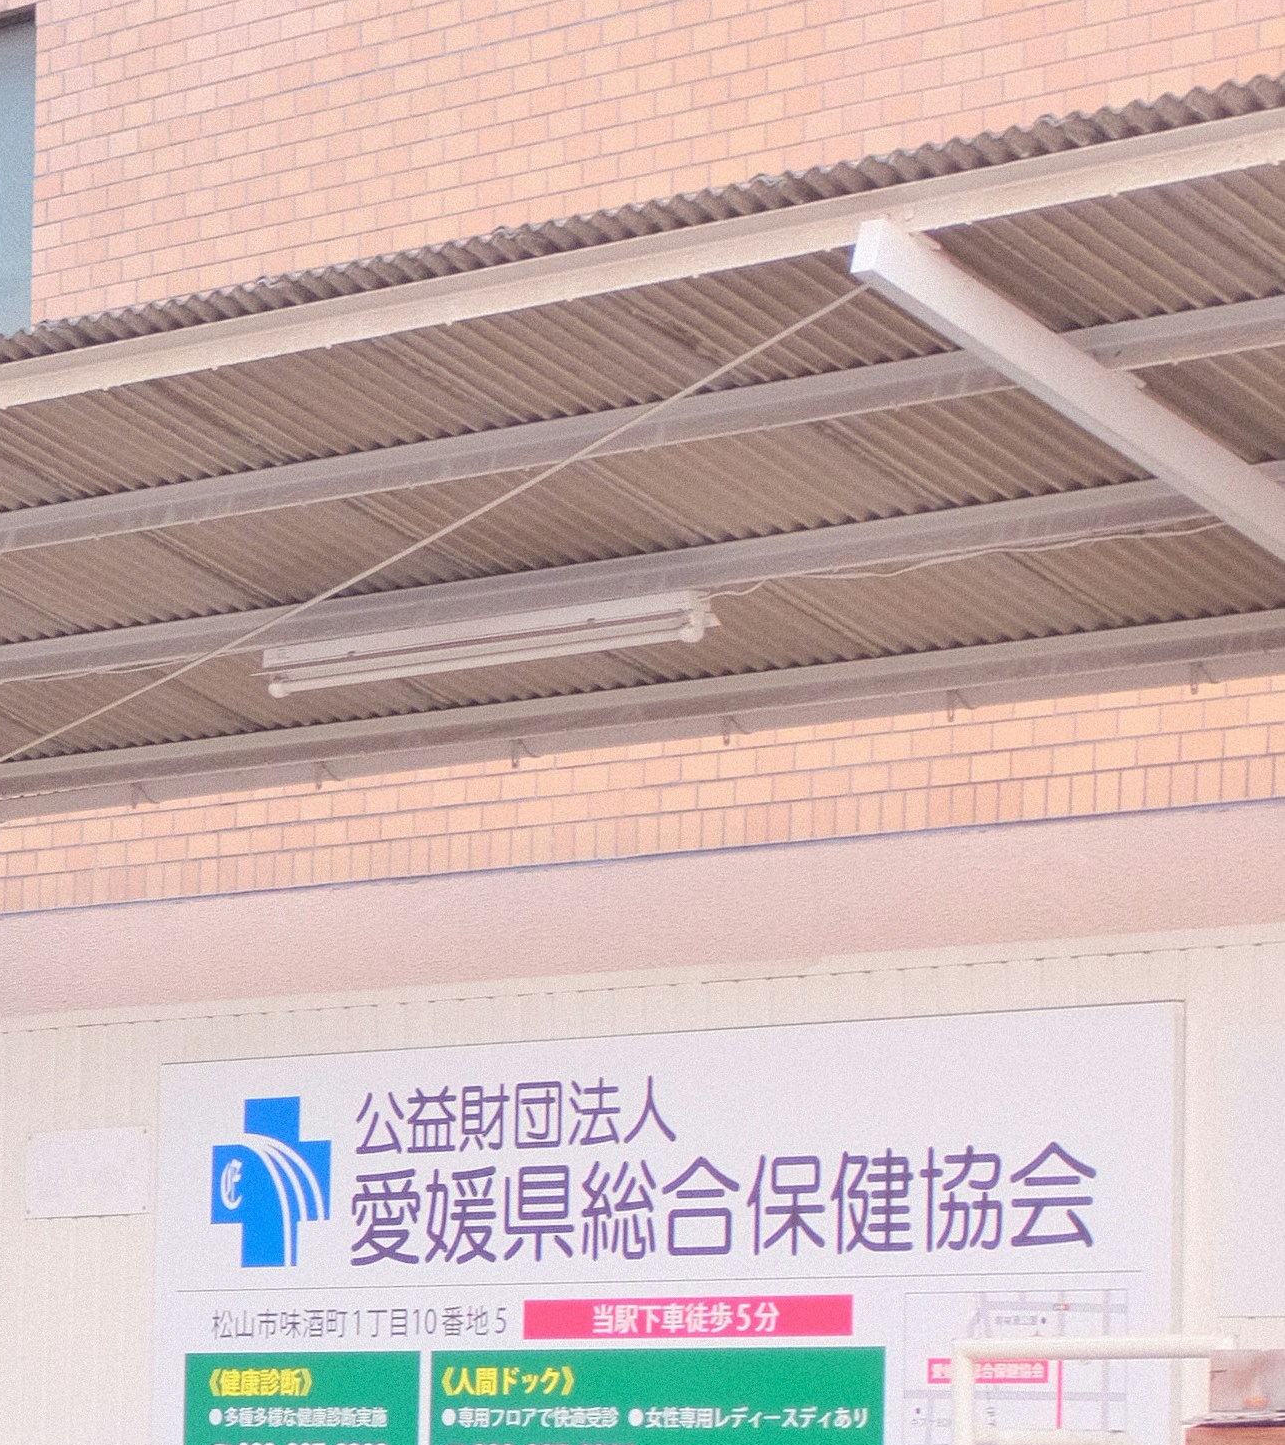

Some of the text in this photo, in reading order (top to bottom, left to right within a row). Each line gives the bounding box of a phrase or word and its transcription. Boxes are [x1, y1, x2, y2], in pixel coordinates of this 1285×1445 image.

[355, 1074, 677, 1155] 公益財団法人
[350, 1140, 1097, 1267] 愛媛県総合保健協会
[591, 1301, 781, 1334] 当駅下車徒歩5分
